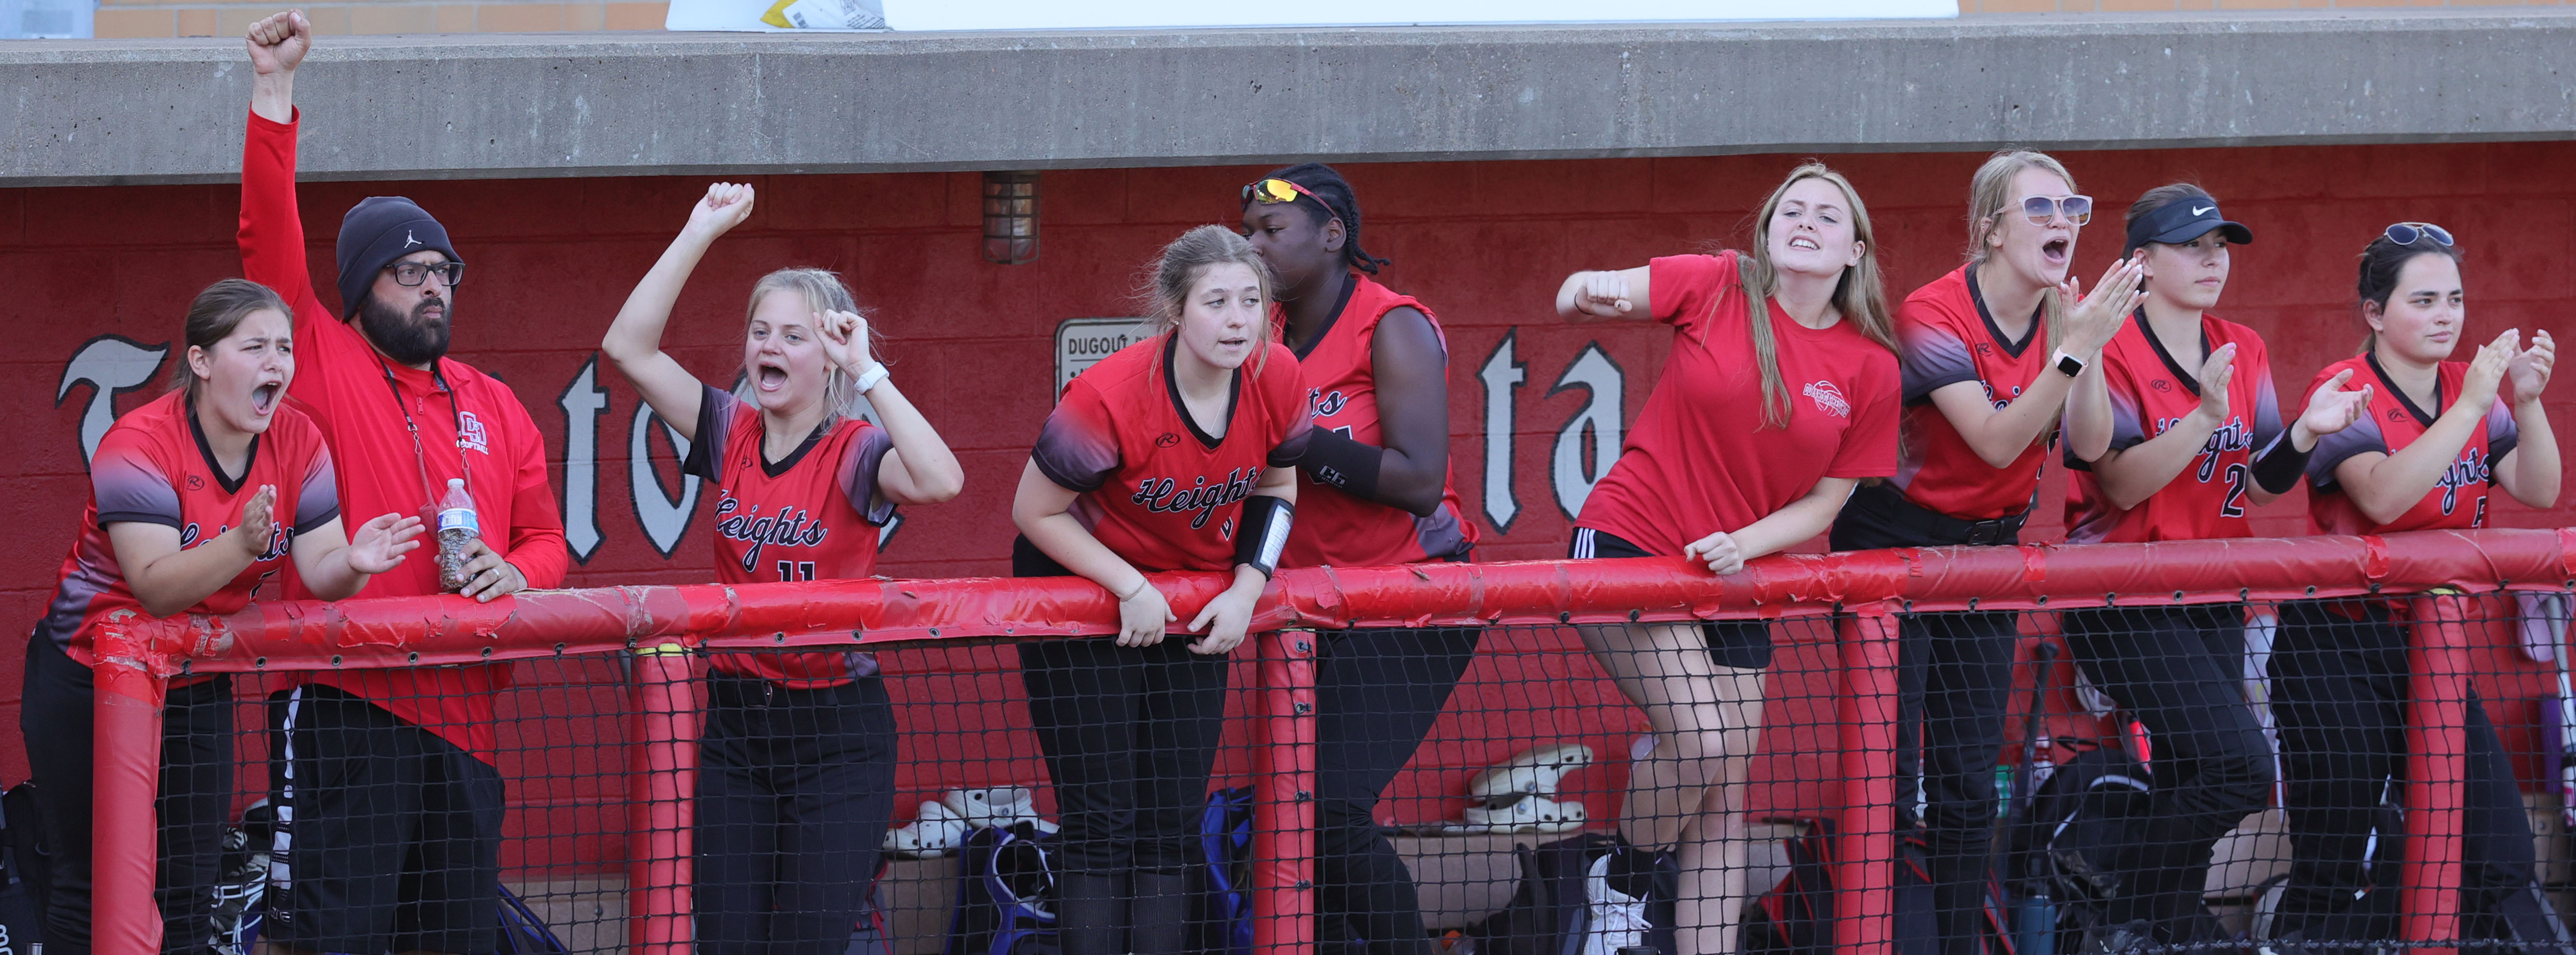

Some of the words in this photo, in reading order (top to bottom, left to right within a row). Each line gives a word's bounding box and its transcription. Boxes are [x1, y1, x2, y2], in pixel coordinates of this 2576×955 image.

[1069, 336, 1128, 355] DUGOUT
[1131, 466, 1267, 529] Height
[2220, 463, 2247, 518] 2
